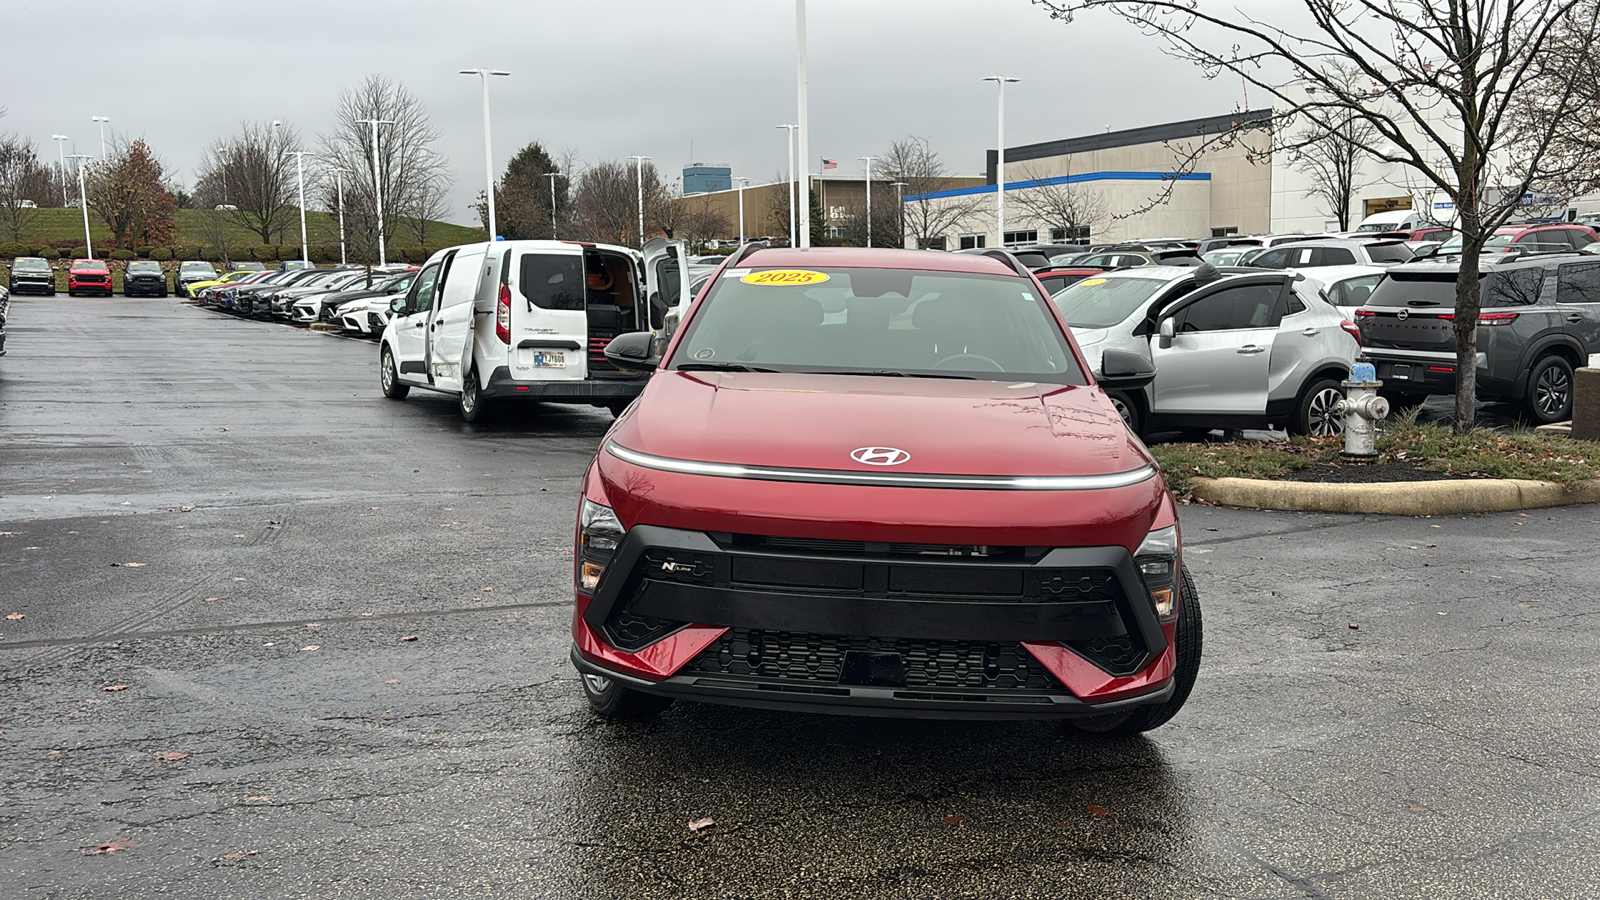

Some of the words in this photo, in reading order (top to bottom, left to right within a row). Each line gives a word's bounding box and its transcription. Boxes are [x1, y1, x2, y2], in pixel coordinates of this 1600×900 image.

[753, 272, 817, 283] 2025
[1366, 322, 1448, 331] PATHFINDER
[661, 562, 677, 571] N
